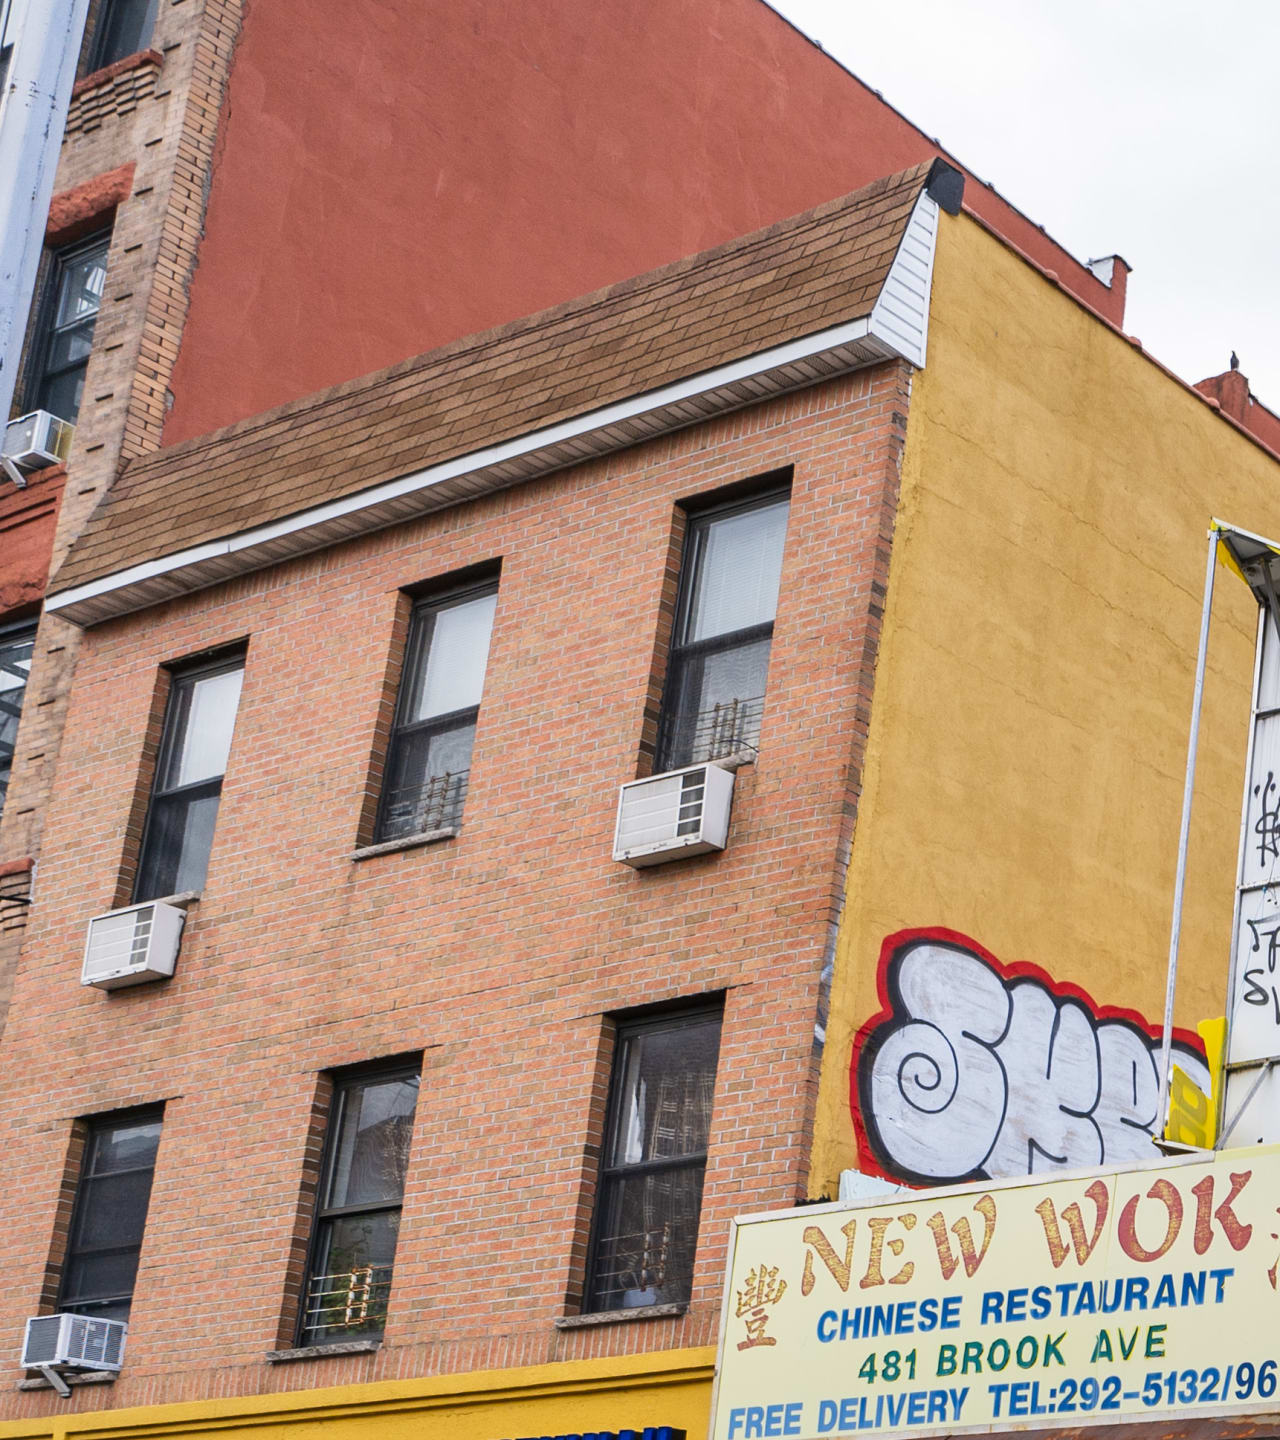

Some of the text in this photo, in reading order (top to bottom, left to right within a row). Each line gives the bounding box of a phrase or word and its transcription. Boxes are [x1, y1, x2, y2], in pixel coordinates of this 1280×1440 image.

[801, 1169, 1253, 1297] NEW WOK
[817, 1268, 1234, 1344] CHINESE RESTAURANT
[858, 1324, 1167, 1384] 481 BROOK AVE
[728, 1402, 802, 1440] FREE
[817, 1387, 969, 1433] DELIVERY
